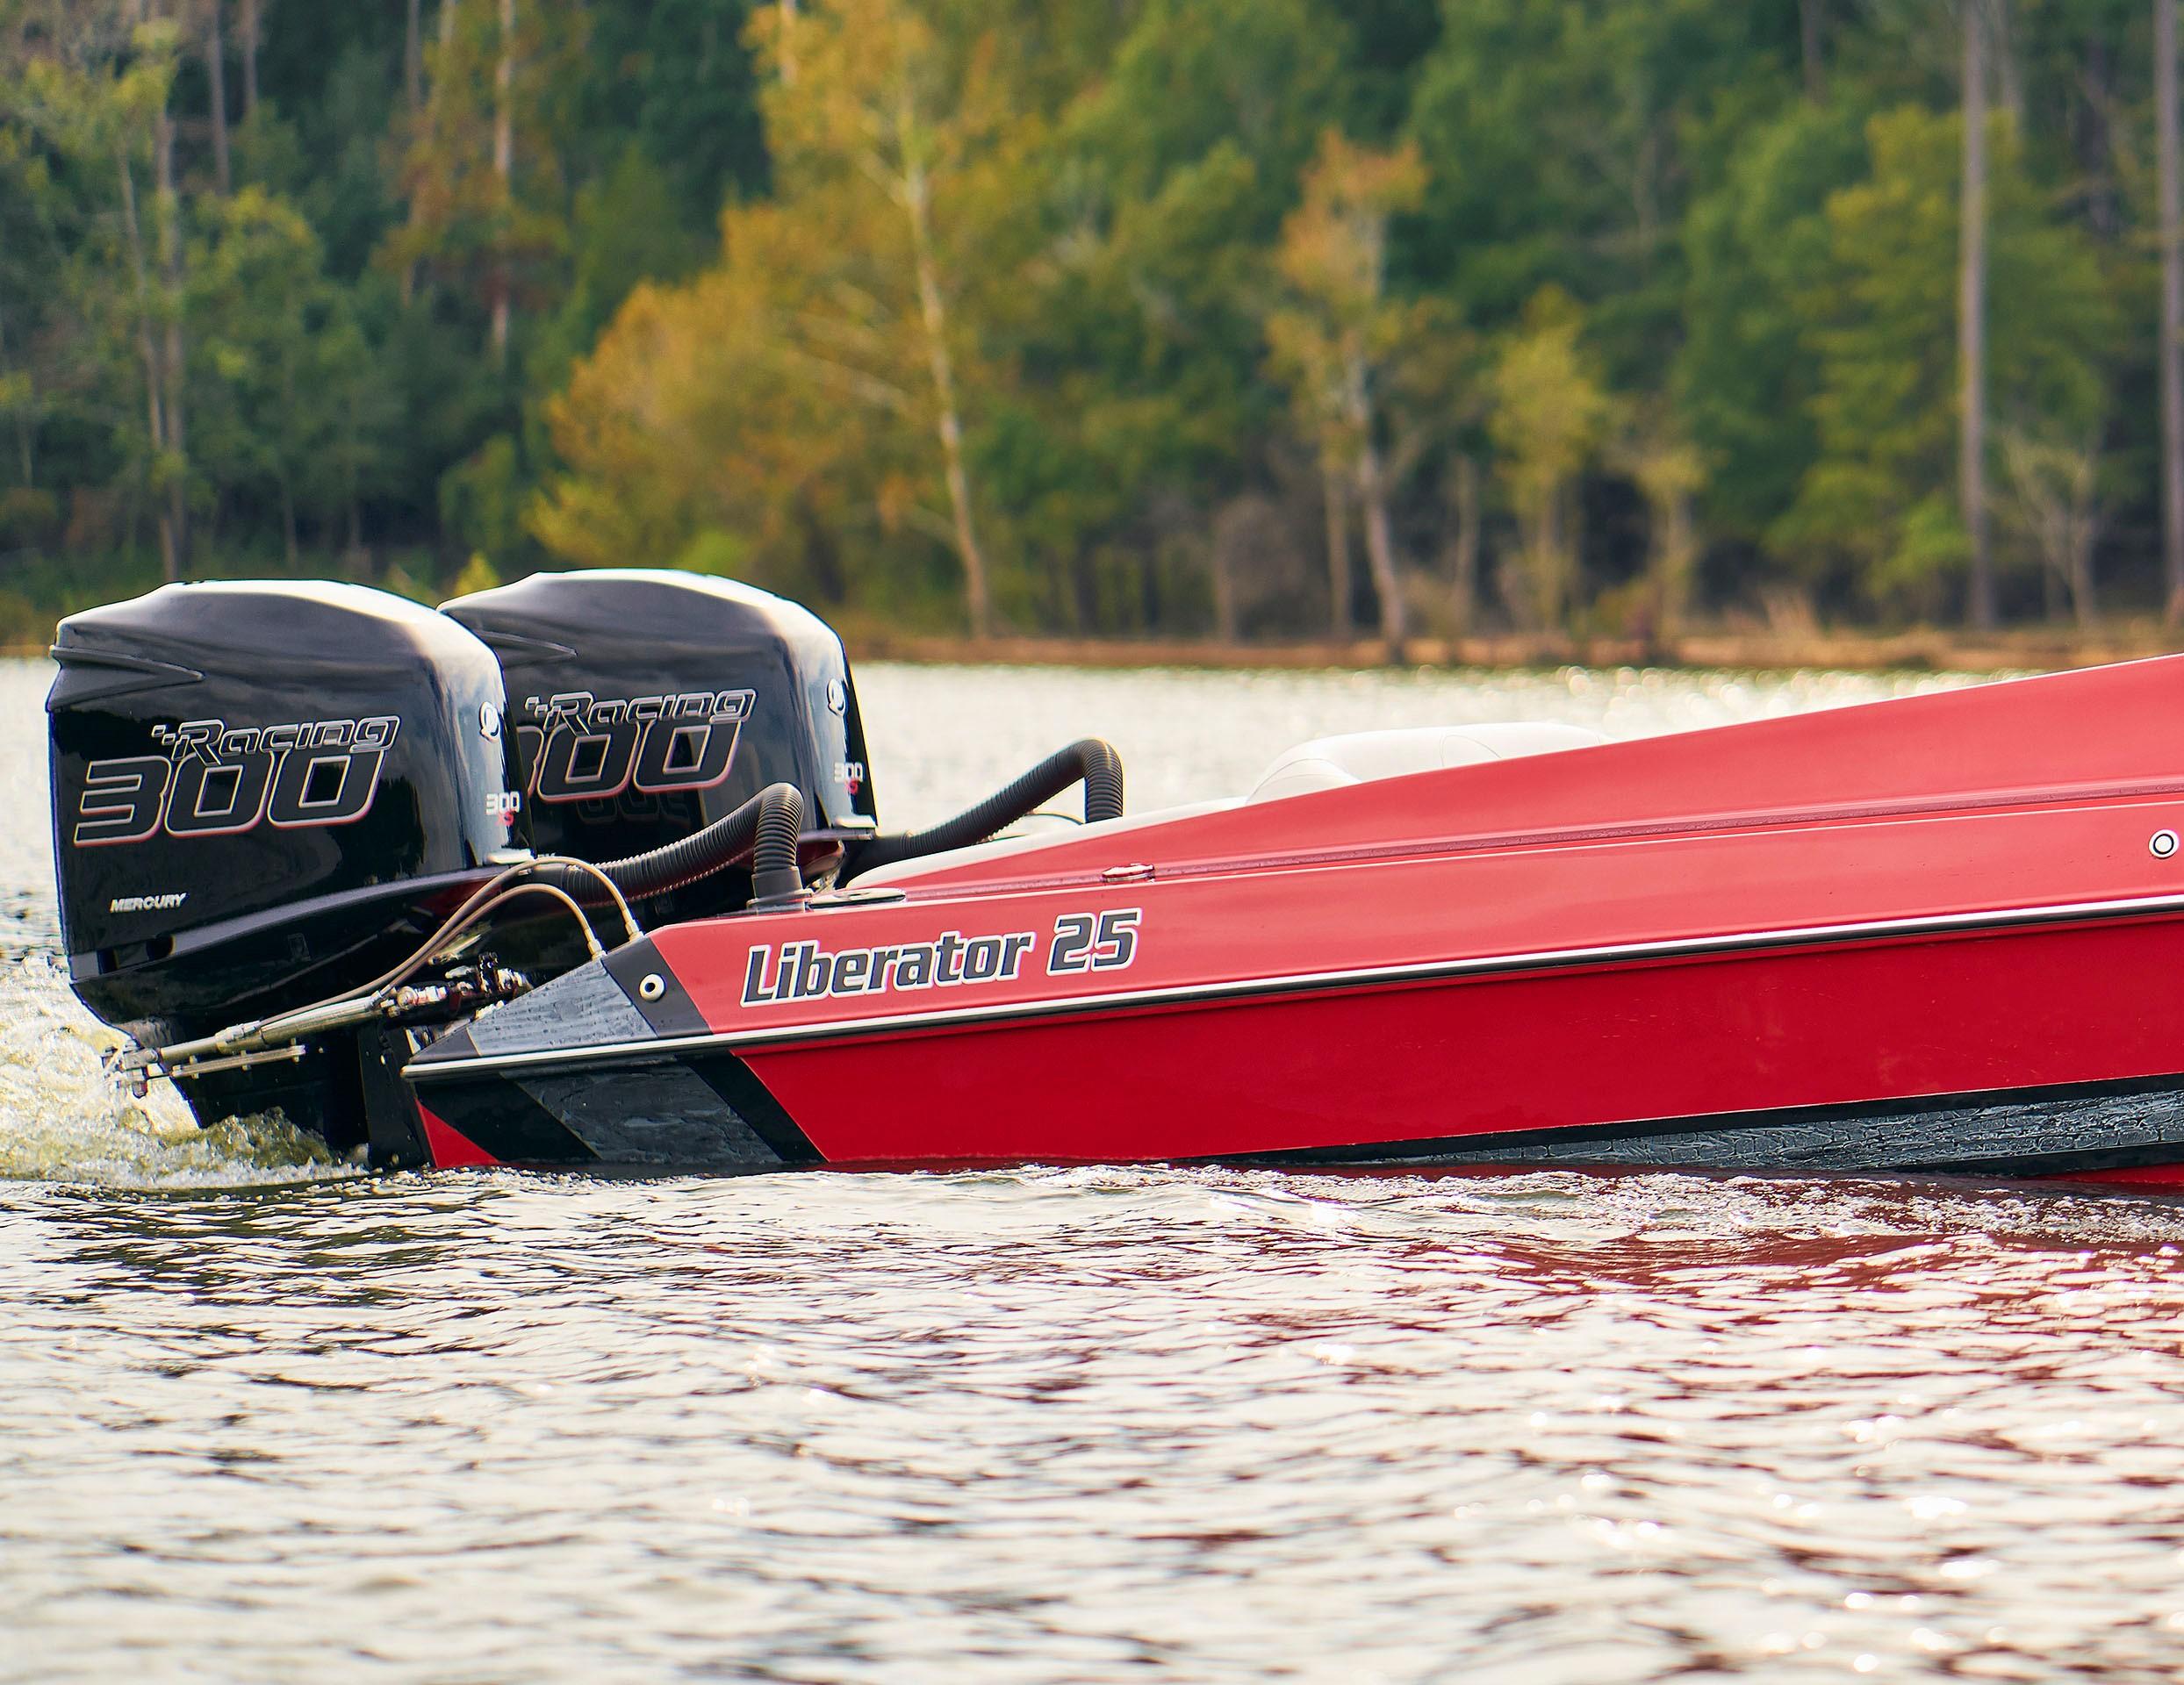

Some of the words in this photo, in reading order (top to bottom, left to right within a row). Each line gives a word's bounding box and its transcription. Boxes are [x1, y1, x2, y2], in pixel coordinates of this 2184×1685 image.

[542, 689, 758, 736] Racing
[172, 715, 401, 766] Racing
[834, 762, 865, 783] 300
[74, 749, 386, 848] 300
[485, 791, 521, 815] 300
[109, 893, 187, 913] MERCURY
[740, 930, 1038, 1008] Liberator
[1045, 907, 1143, 977] 25
